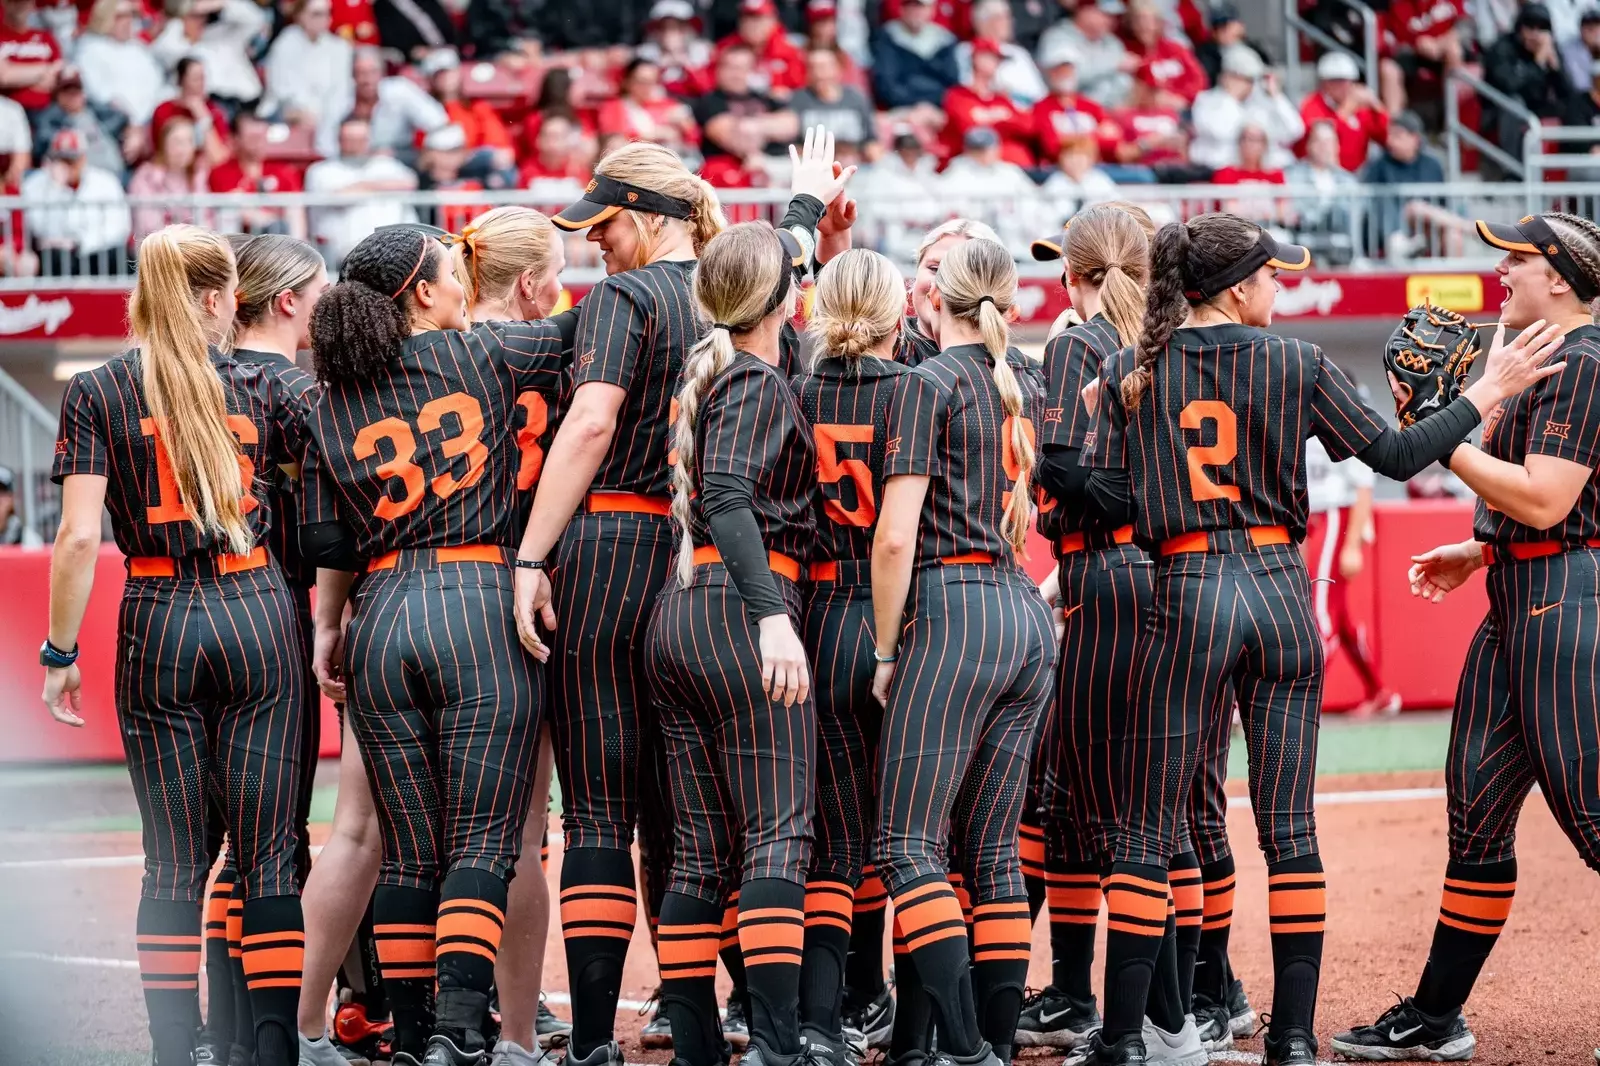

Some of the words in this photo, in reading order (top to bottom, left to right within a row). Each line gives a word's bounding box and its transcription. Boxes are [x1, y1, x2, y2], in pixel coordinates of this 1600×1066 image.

[353, 391, 489, 522] 33
[813, 424, 876, 527] 5
[1180, 400, 1241, 502] 2
